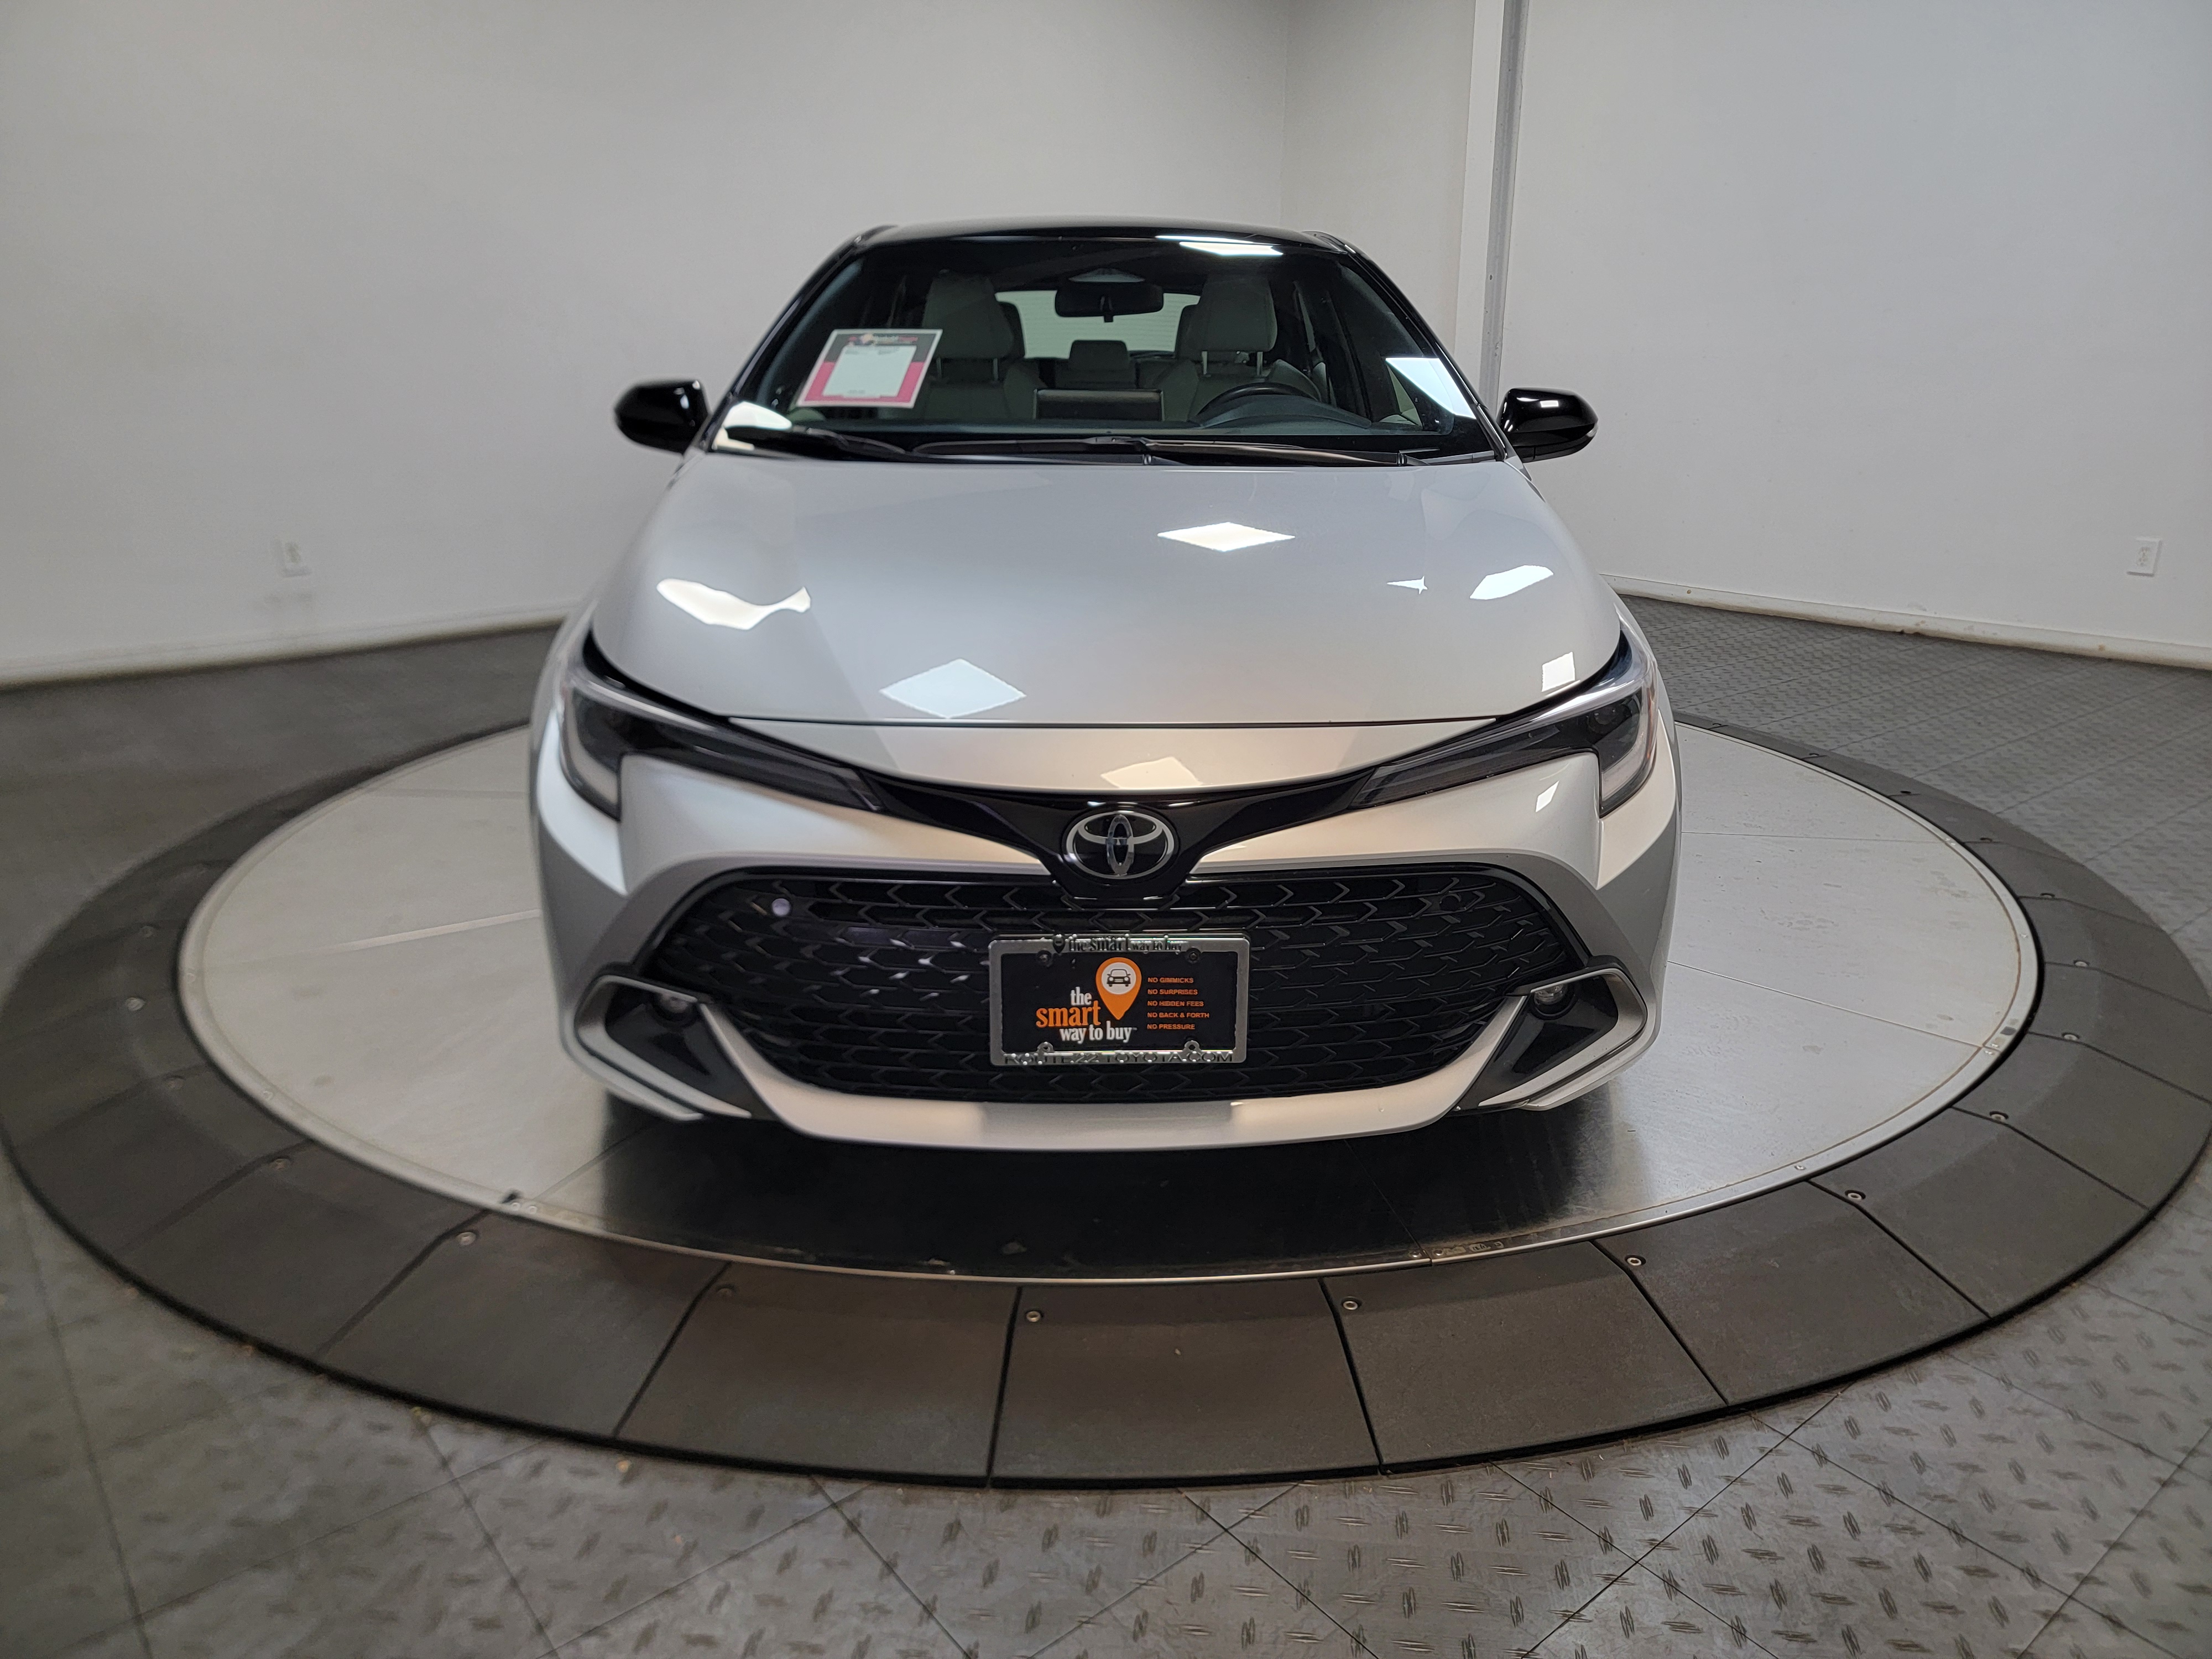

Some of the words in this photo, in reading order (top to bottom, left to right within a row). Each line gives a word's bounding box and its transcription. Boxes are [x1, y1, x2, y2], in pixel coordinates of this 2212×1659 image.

[1070, 987, 1092, 1006] the
[1036, 1000, 1102, 1028] smart
[1059, 1027, 1087, 1045] way
[1089, 1024, 1104, 1041] to
[1106, 1020, 1133, 1043] buy
